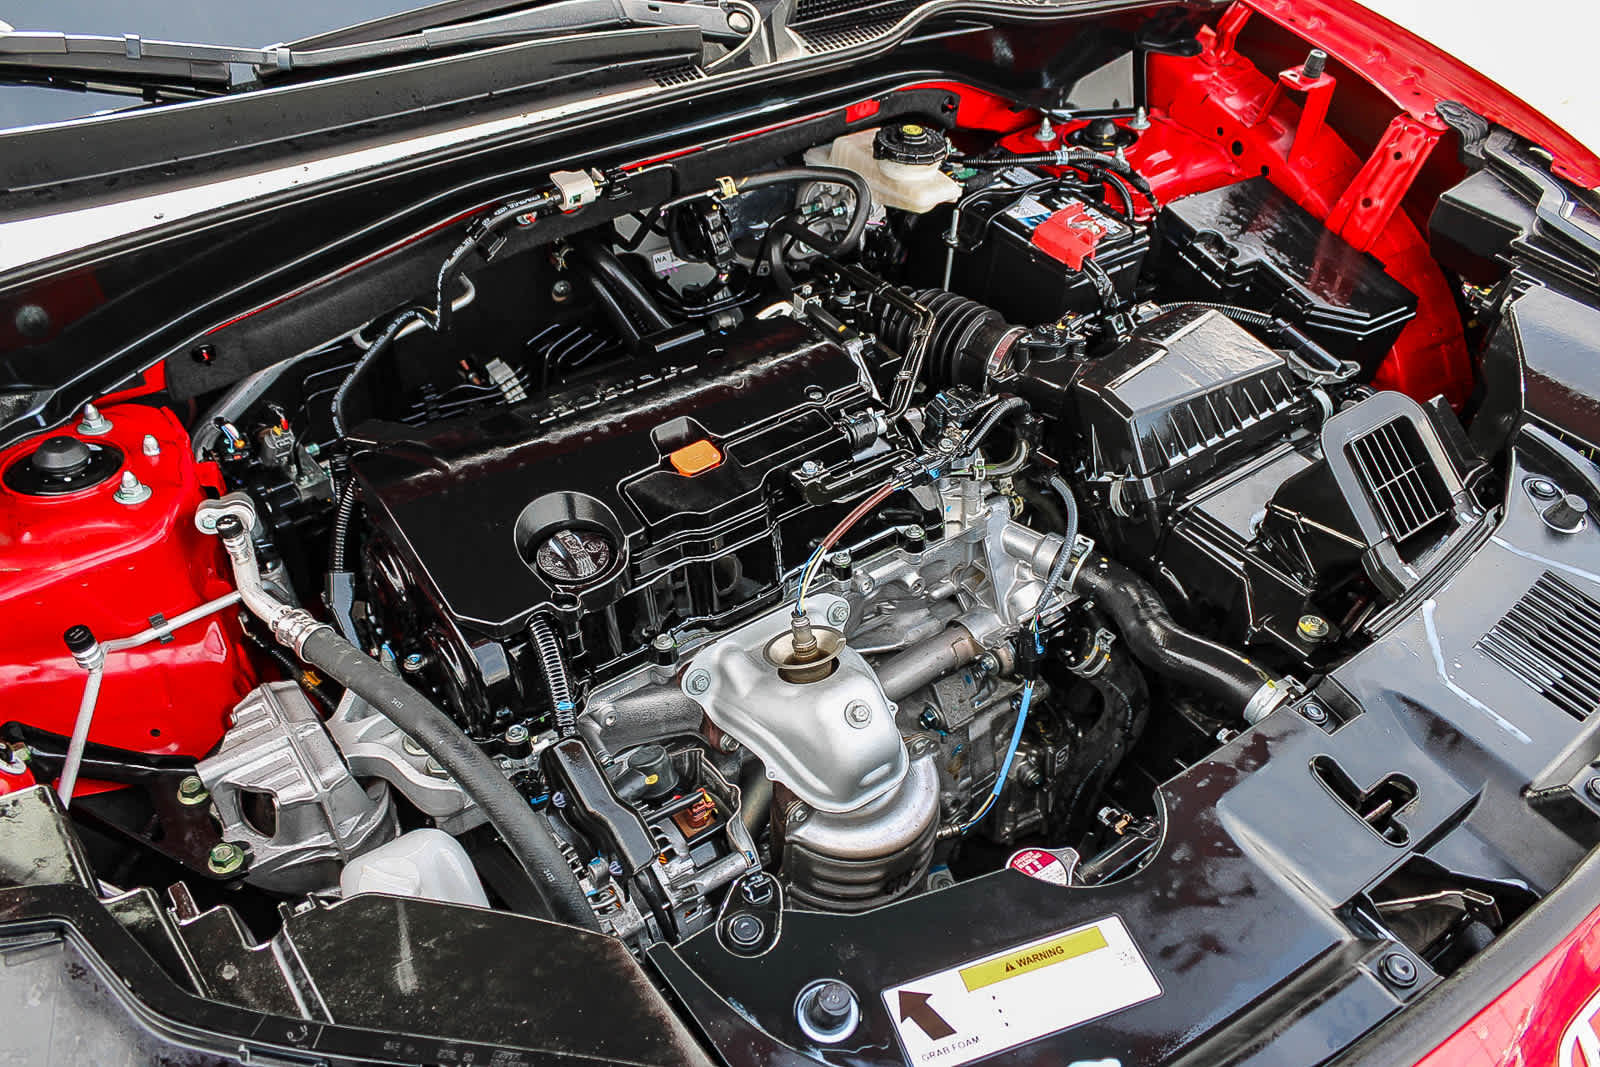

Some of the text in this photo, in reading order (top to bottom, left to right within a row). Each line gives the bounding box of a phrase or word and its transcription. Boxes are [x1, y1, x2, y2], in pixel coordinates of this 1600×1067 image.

[1016, 945, 1065, 969] WARNING
[921, 1035, 980, 1063] GRAB FOAM
